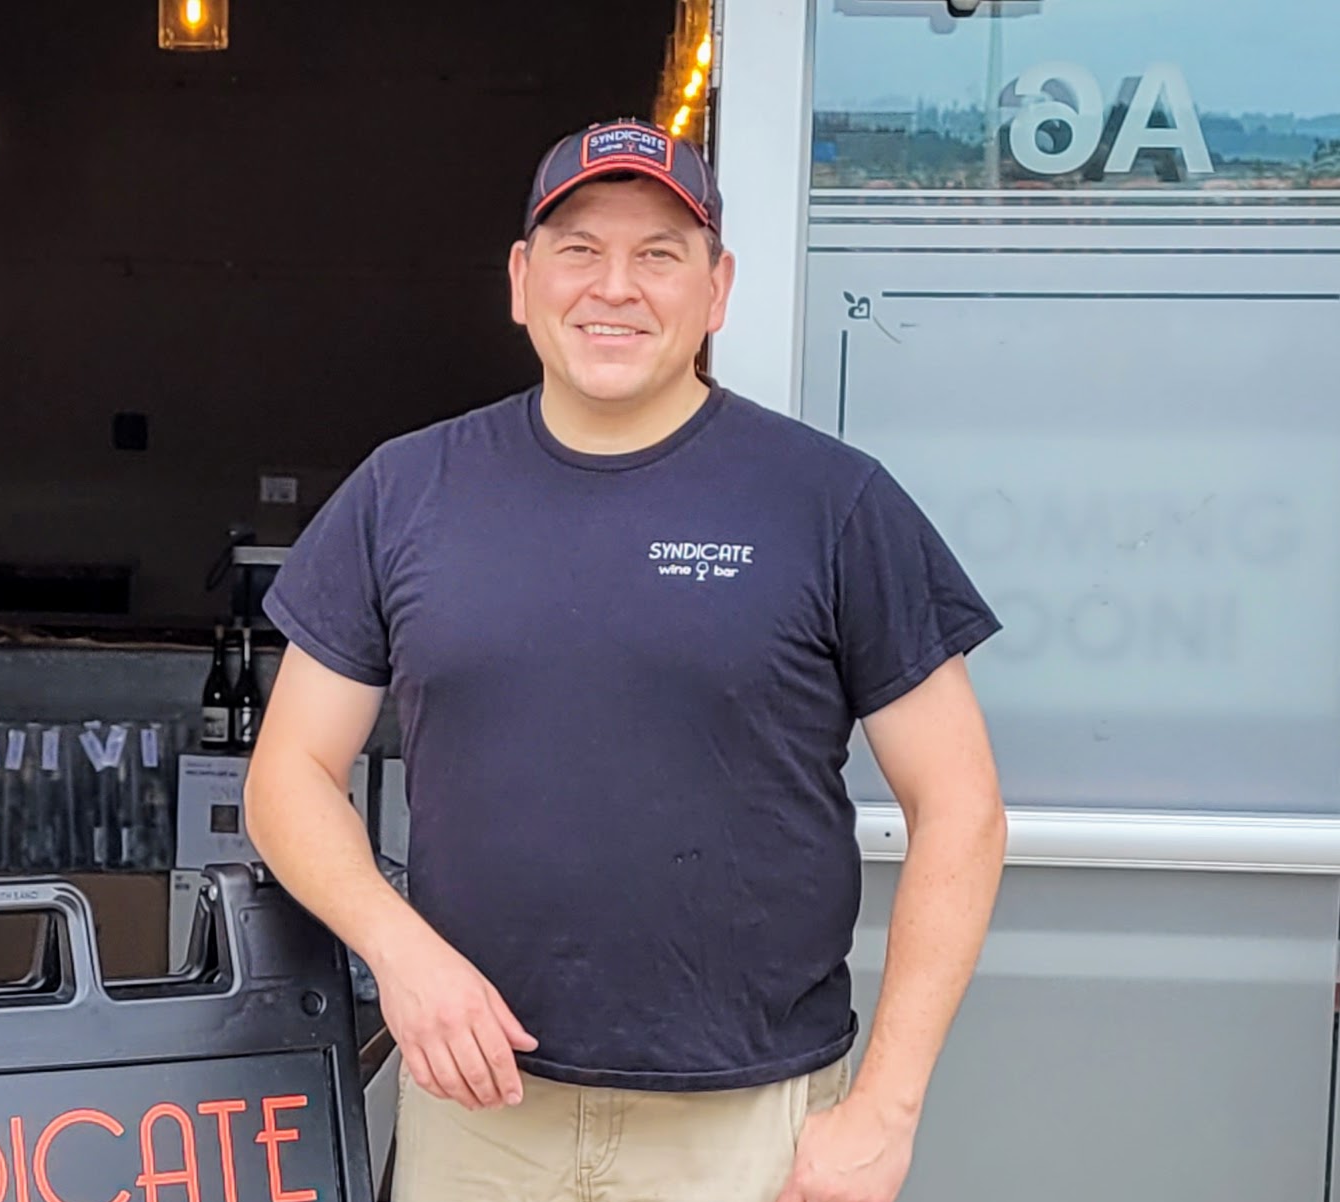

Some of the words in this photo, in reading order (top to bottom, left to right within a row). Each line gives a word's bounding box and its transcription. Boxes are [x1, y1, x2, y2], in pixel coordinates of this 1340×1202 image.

[590, 130, 666, 152] SYNDICATE
[648, 542, 754, 563] SYNDICATE
[658, 564, 692, 575] wine
[713, 564, 739, 577] bar
